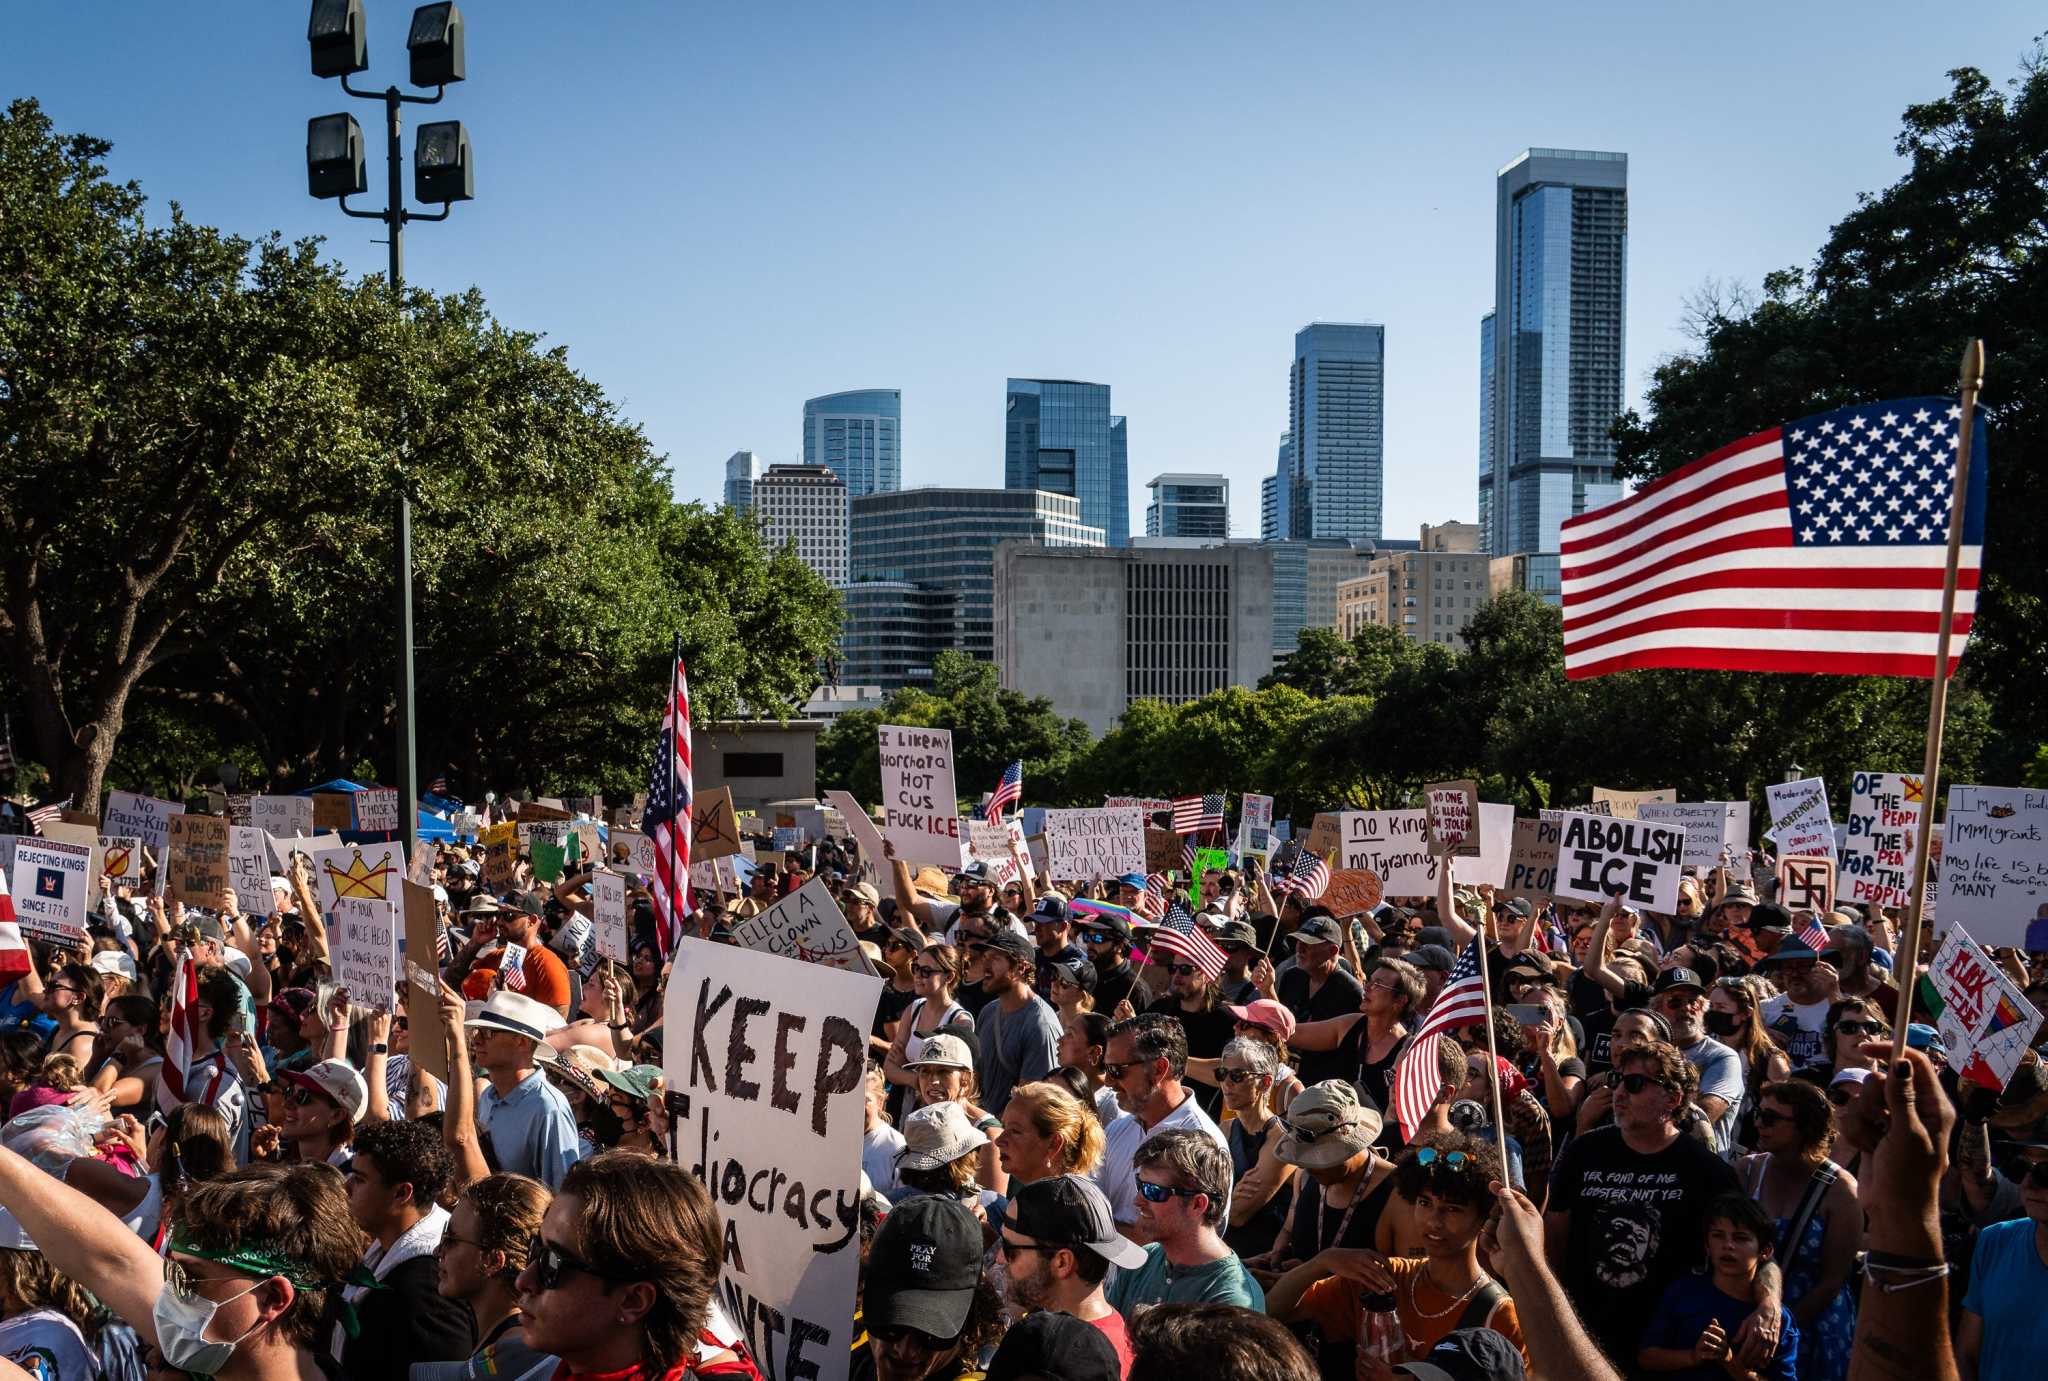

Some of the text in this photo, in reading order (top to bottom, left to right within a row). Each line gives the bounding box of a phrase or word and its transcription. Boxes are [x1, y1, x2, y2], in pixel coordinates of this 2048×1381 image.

[880, 731, 889, 746] I
[901, 771, 935, 791] HOT
[1853, 773, 1884, 795] OF
[899, 790, 935, 810] CUS
[1445, 791, 1464, 805] ONE
[1870, 793, 1901, 811] THE
[107, 807, 170, 833] Faux-Kin
[887, 808, 924, 831] FUCK
[1432, 806, 1472, 818] IS ILLEGAL
[1067, 815, 1121, 837] HISTORY
[1431, 817, 1473, 833] ON STOLEN
[1848, 813, 1876, 837] BY
[112, 837, 136, 848] KINGS
[1111, 837, 1141, 857] EYES
[1563, 817, 1685, 866] ABOLISH
[1871, 832, 1902, 851] THE
[18, 849, 86, 873] REJECTING KINGS
[1073, 856, 1125, 875] ON YOU
[1370, 852, 1439, 882] Tyranny
[1841, 848, 1875, 877] FOR
[1570, 850, 1658, 905] ICE
[1952, 882, 1997, 899] MANY
[22, 898, 69, 919] SINCE 1776
[739, 892, 814, 946] ELECT A
[767, 912, 822, 954] CLOWN
[1945, 948, 1997, 1015] FUCK
[689, 976, 866, 1138] KEEP
[1583, 1171, 1678, 1185] YER FOND OF ME
[1580, 1186, 1628, 1201] LOBSTER
[1661, 1188, 1684, 1201] YE?
[722, 1217, 747, 1276] A
[910, 1244, 937, 1255] PRAY
[911, 1252, 932, 1263] FOR
